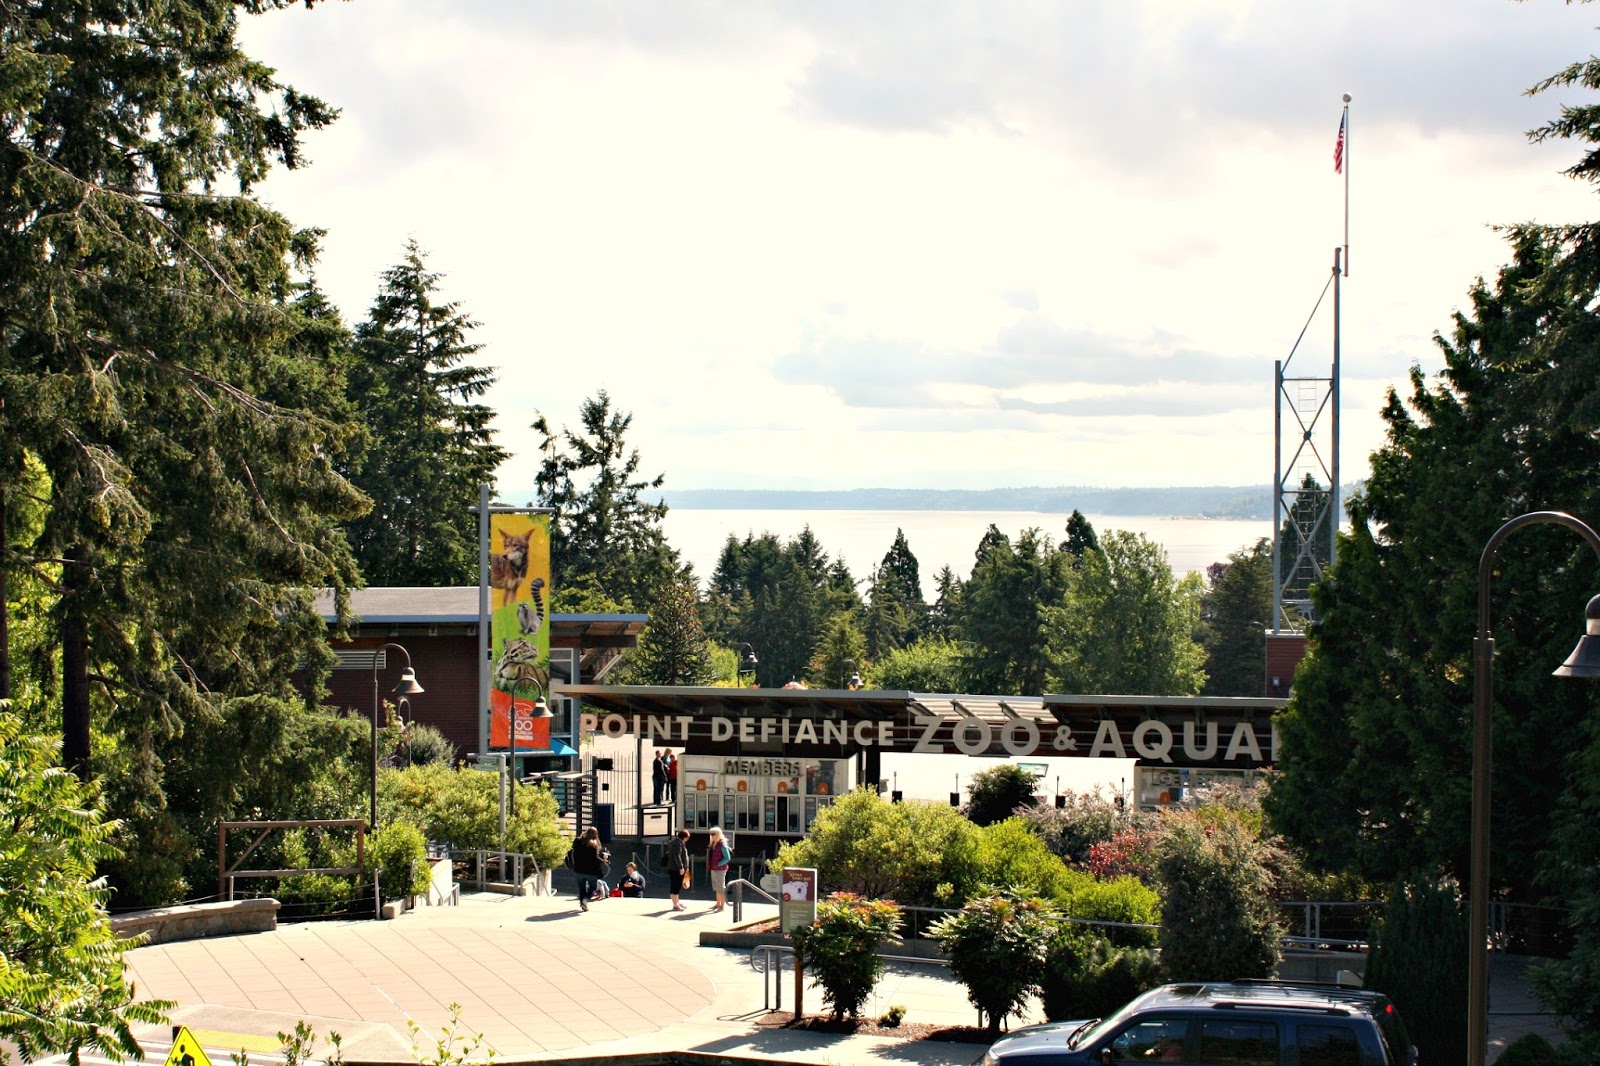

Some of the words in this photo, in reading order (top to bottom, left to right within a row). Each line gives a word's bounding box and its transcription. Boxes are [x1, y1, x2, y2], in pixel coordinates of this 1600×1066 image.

[580, 713, 693, 740] POINT
[711, 717, 894, 746] DEFIANCE
[911, 715, 1040, 756] ZOO
[1053, 725, 1078, 750] &
[724, 760, 799, 777] MEMBERS
